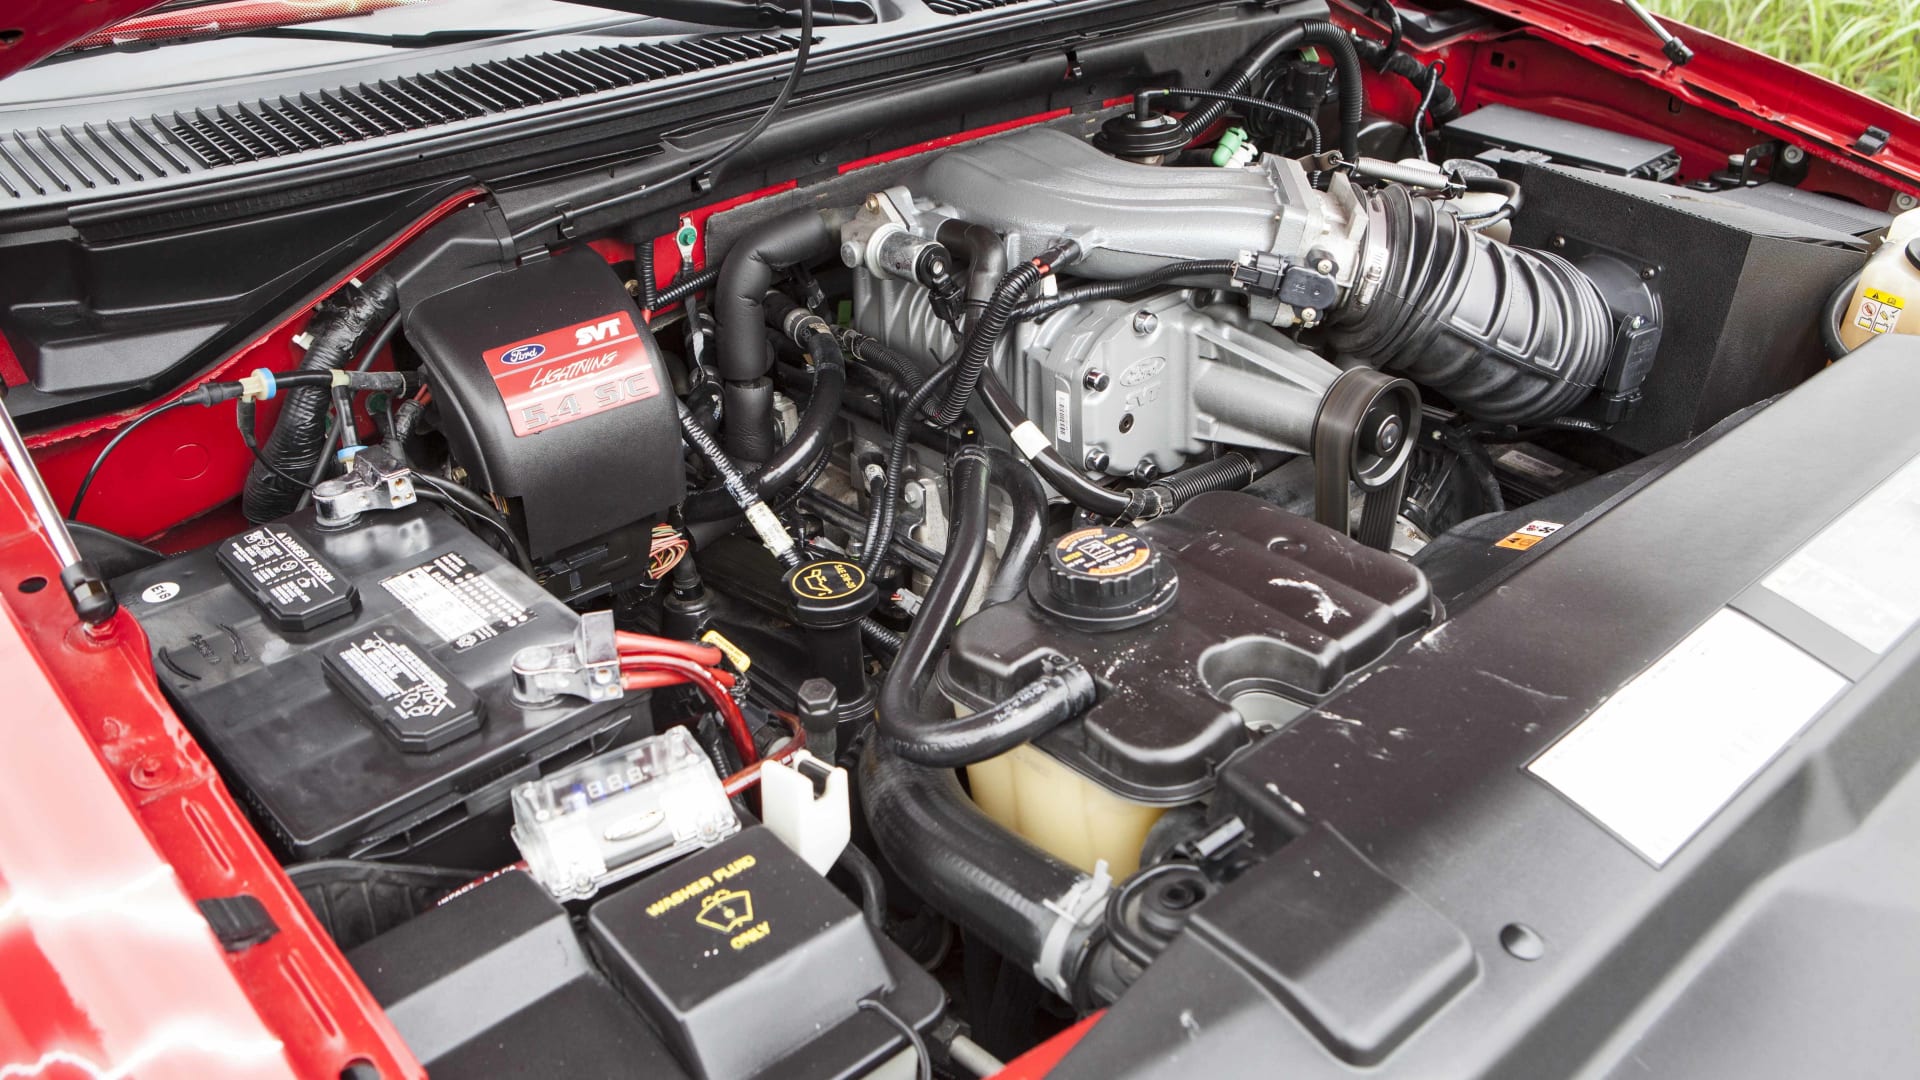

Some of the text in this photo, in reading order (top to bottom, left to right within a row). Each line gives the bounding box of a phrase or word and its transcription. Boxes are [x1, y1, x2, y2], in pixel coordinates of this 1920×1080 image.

[576, 318, 621, 346] SVT
[506, 346, 541, 363] Ford
[529, 350, 619, 389] LIGHTNING
[521, 372, 649, 430] 5.4 S/C
[282, 537, 310, 560] DANGER
[308, 561, 336, 583] POISON
[645, 854, 757, 917] WASHER FLUID
[730, 920, 771, 950] ONLY
